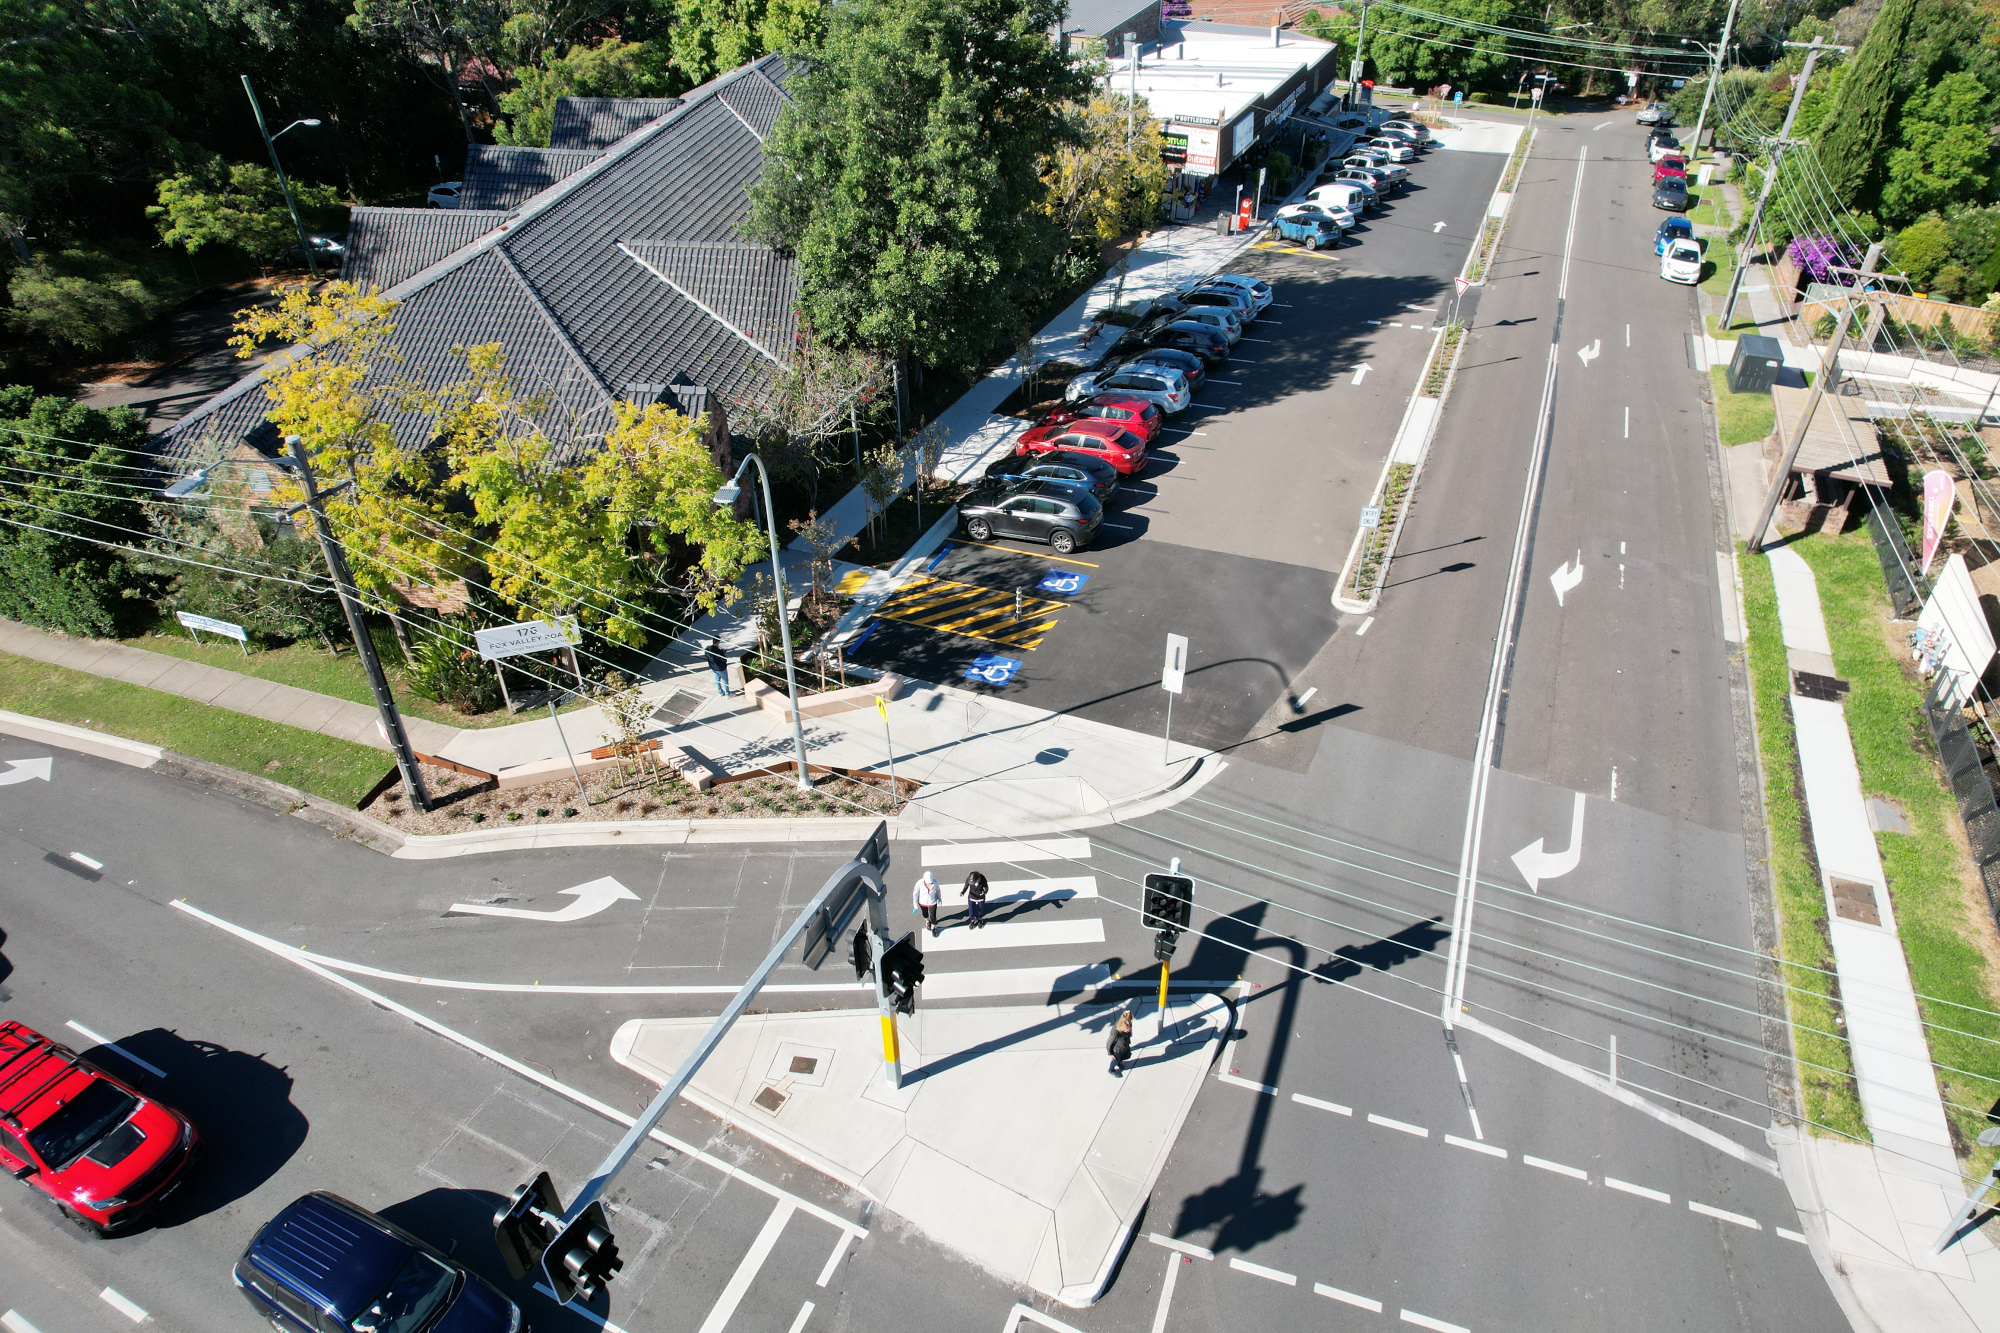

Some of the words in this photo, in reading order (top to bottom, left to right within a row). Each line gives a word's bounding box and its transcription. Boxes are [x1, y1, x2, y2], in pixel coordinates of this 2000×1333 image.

[1180, 115, 1213, 125] BOTTLESHOP
[1187, 155, 1215, 165] CHEMIST
[490, 641, 507, 650] FOX
[510, 636, 542, 646] VALLEY
